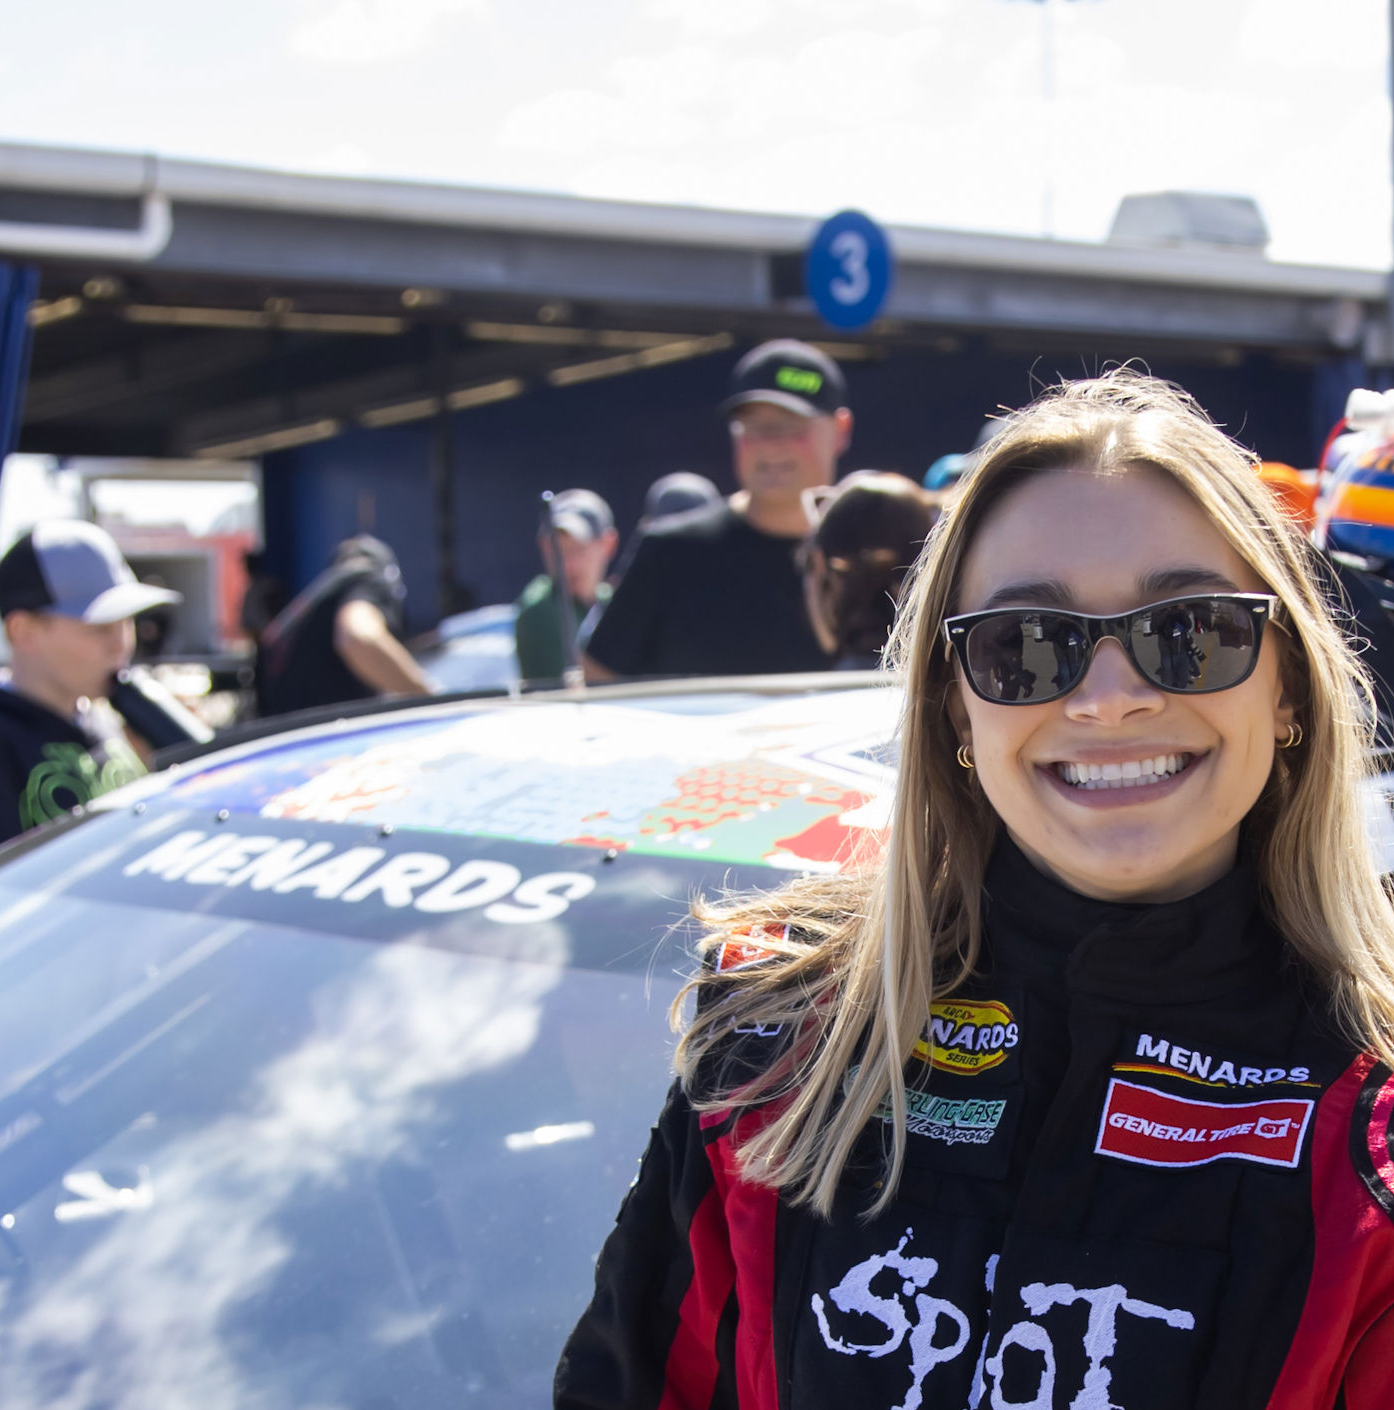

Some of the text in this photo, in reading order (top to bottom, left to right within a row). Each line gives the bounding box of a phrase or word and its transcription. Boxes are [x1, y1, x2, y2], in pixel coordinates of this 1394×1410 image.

[830, 231, 870, 305] 3
[123, 828, 596, 924] MENARDS
[946, 1052, 981, 1067] SERIES
[1135, 1033, 1310, 1086] MENARDS
[1108, 1111, 1206, 1143] GENERAL
[1208, 1122, 1256, 1142] TIRE
